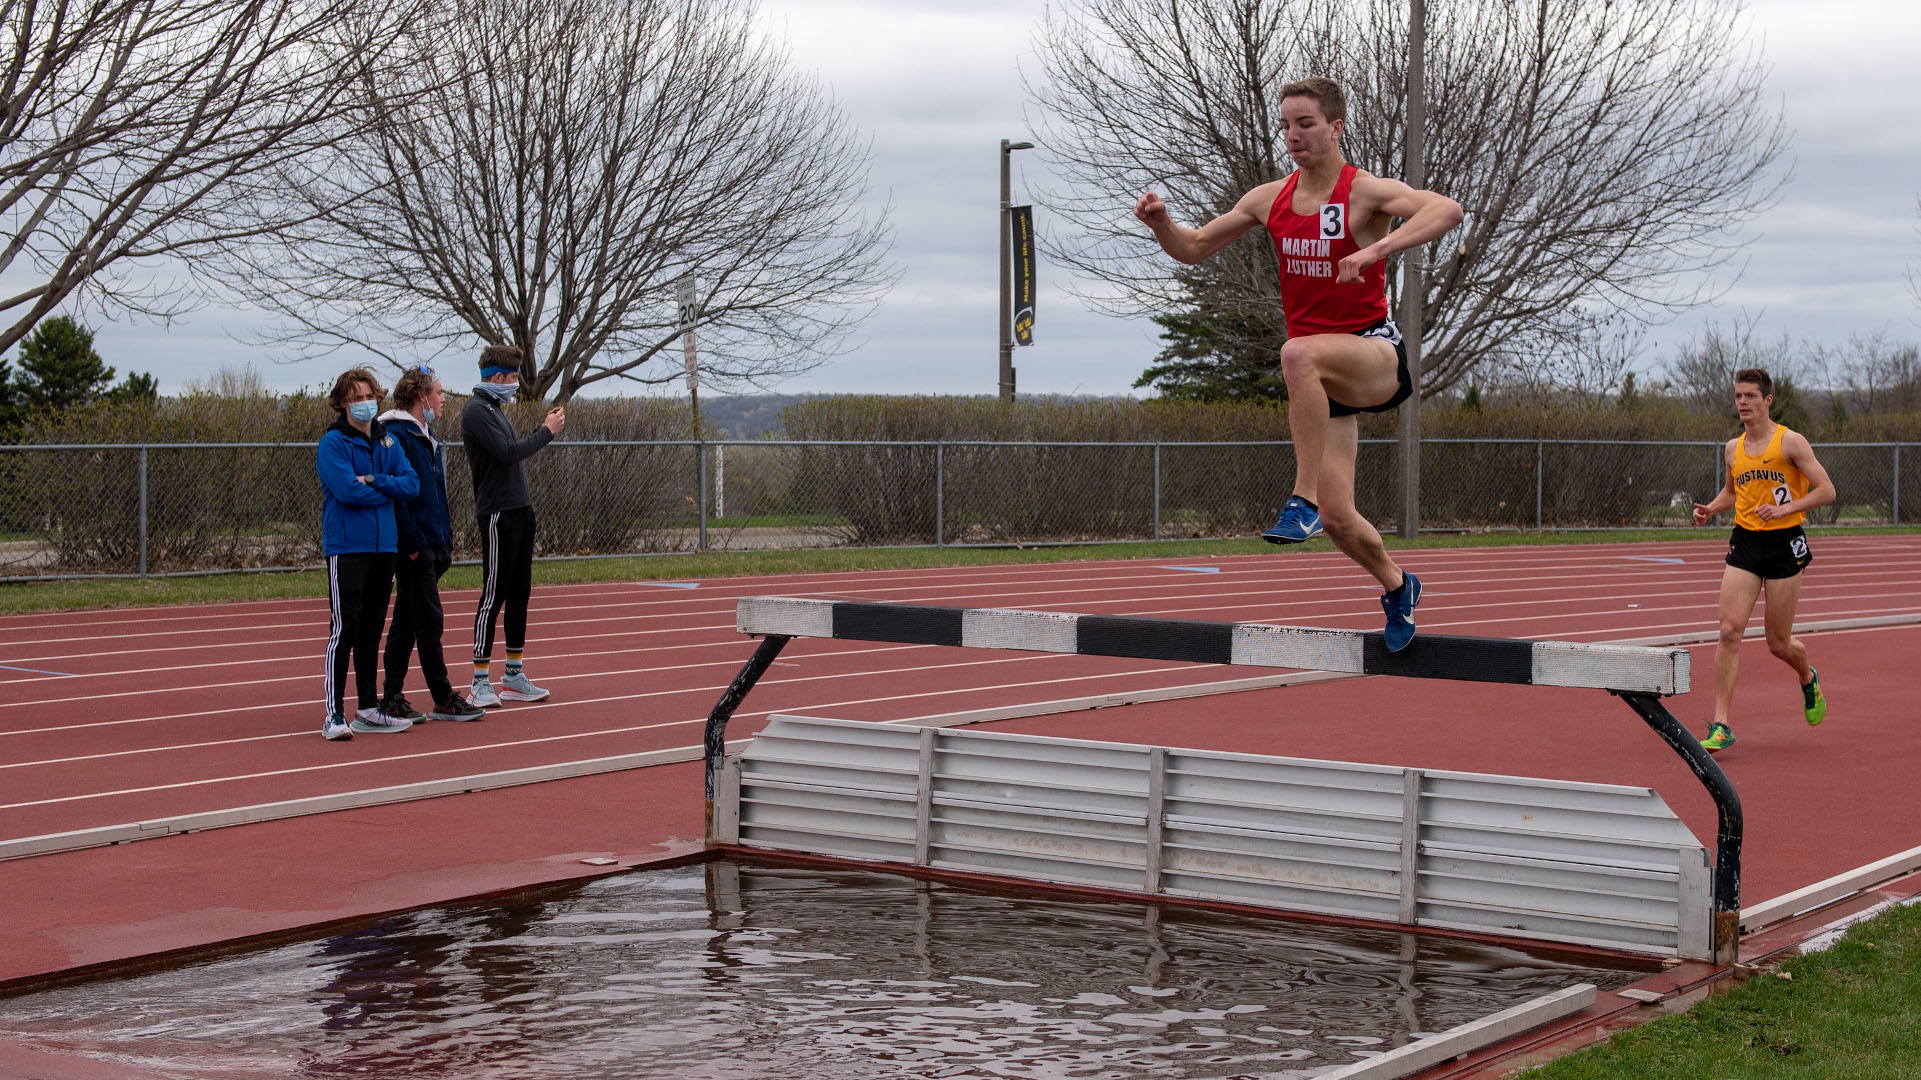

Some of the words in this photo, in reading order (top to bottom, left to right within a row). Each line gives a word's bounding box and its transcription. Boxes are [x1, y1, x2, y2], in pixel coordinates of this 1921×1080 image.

[1323, 205, 1342, 237] 3
[1282, 237, 1331, 258] MARTIN
[1287, 258, 1332, 277] LUTHER
[679, 280, 694, 291] SPEED
[680, 292, 692, 303] LIMIT
[680, 303, 696, 325] 20
[1775, 487, 1791, 506] 2
[1792, 538, 1806, 556] 2
